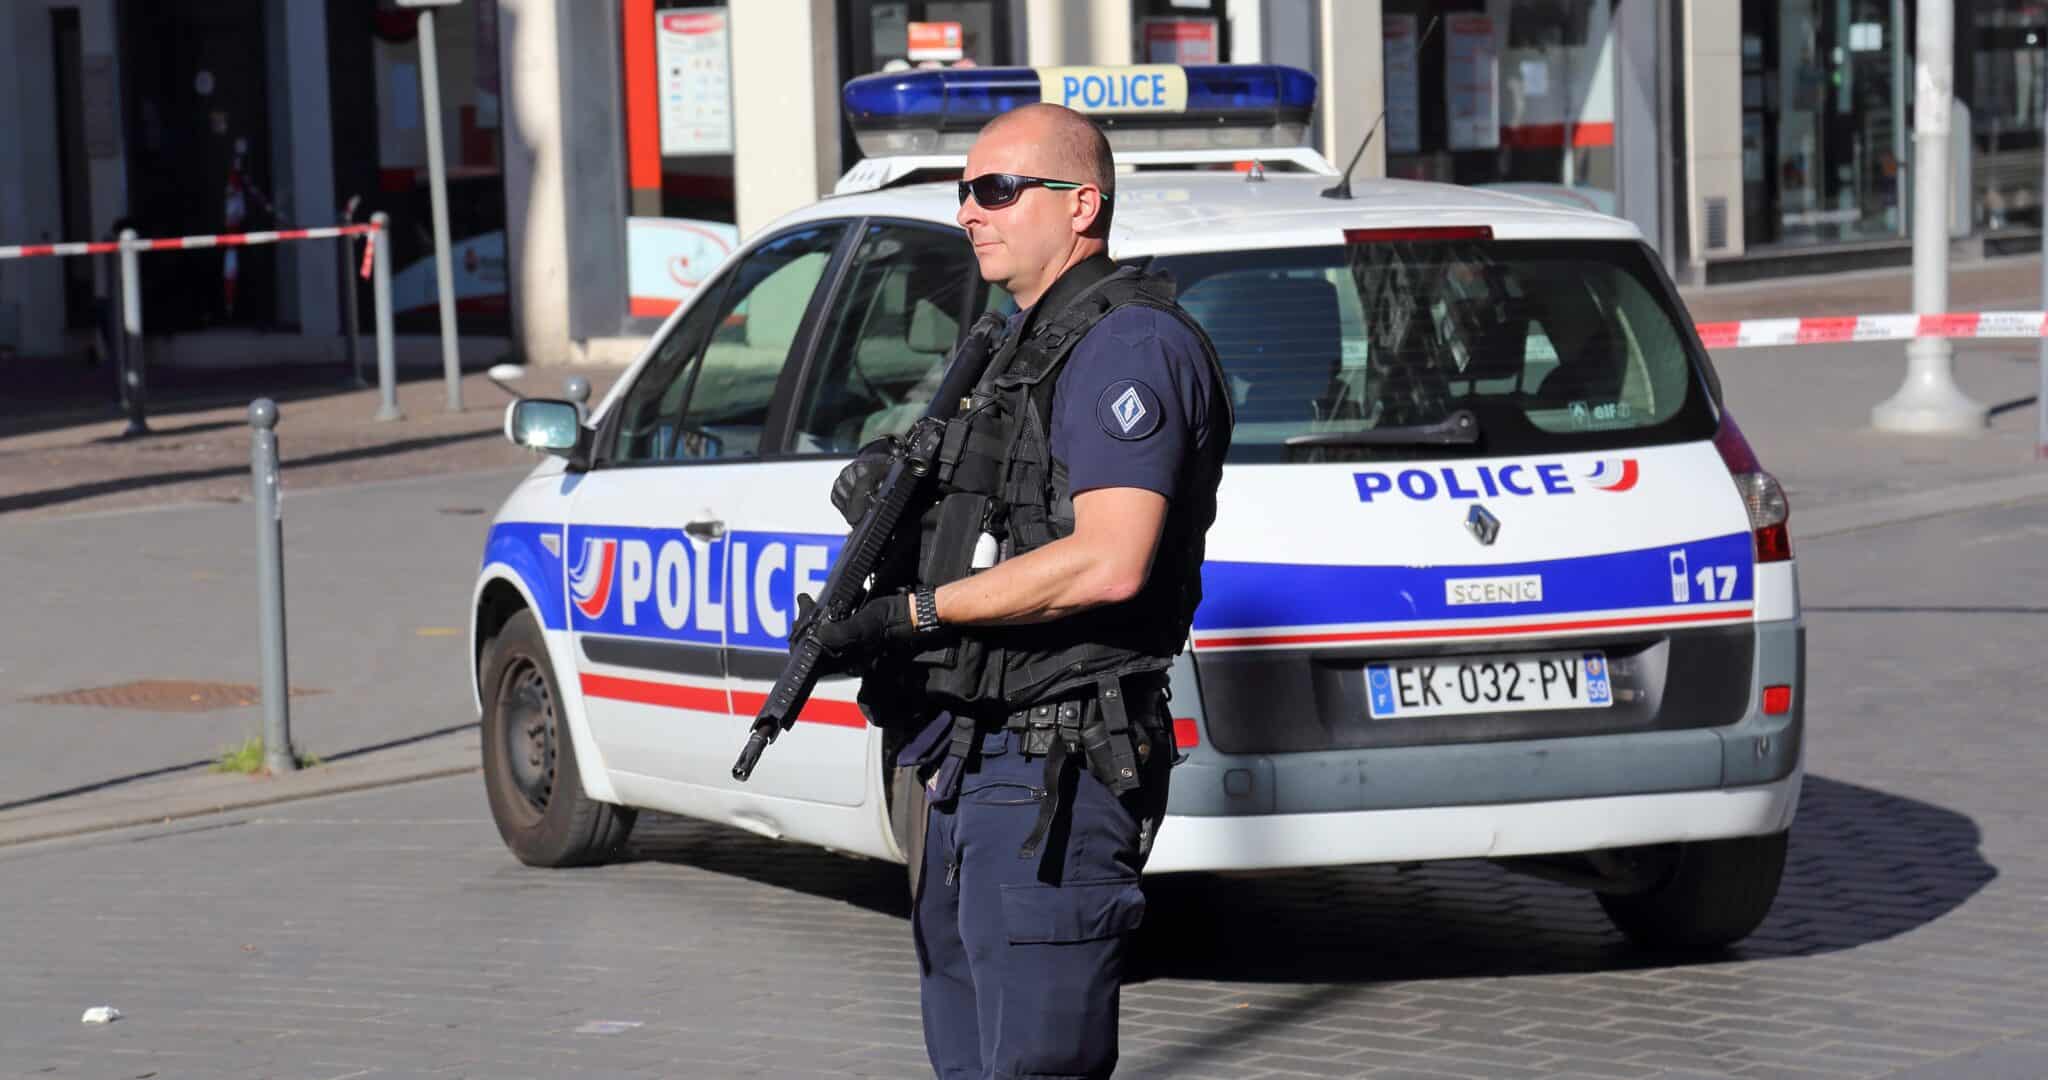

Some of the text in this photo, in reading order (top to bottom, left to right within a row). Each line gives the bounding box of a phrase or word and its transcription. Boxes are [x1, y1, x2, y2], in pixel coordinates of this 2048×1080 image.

[1063, 74, 1165, 107] POLICE
[1353, 464, 1575, 502] POLICE
[1453, 580, 1537, 604] SCENIC
[1695, 565, 1738, 601] 17
[1397, 659, 1578, 708] EK-032-PV
[1587, 680, 1608, 699] 59
